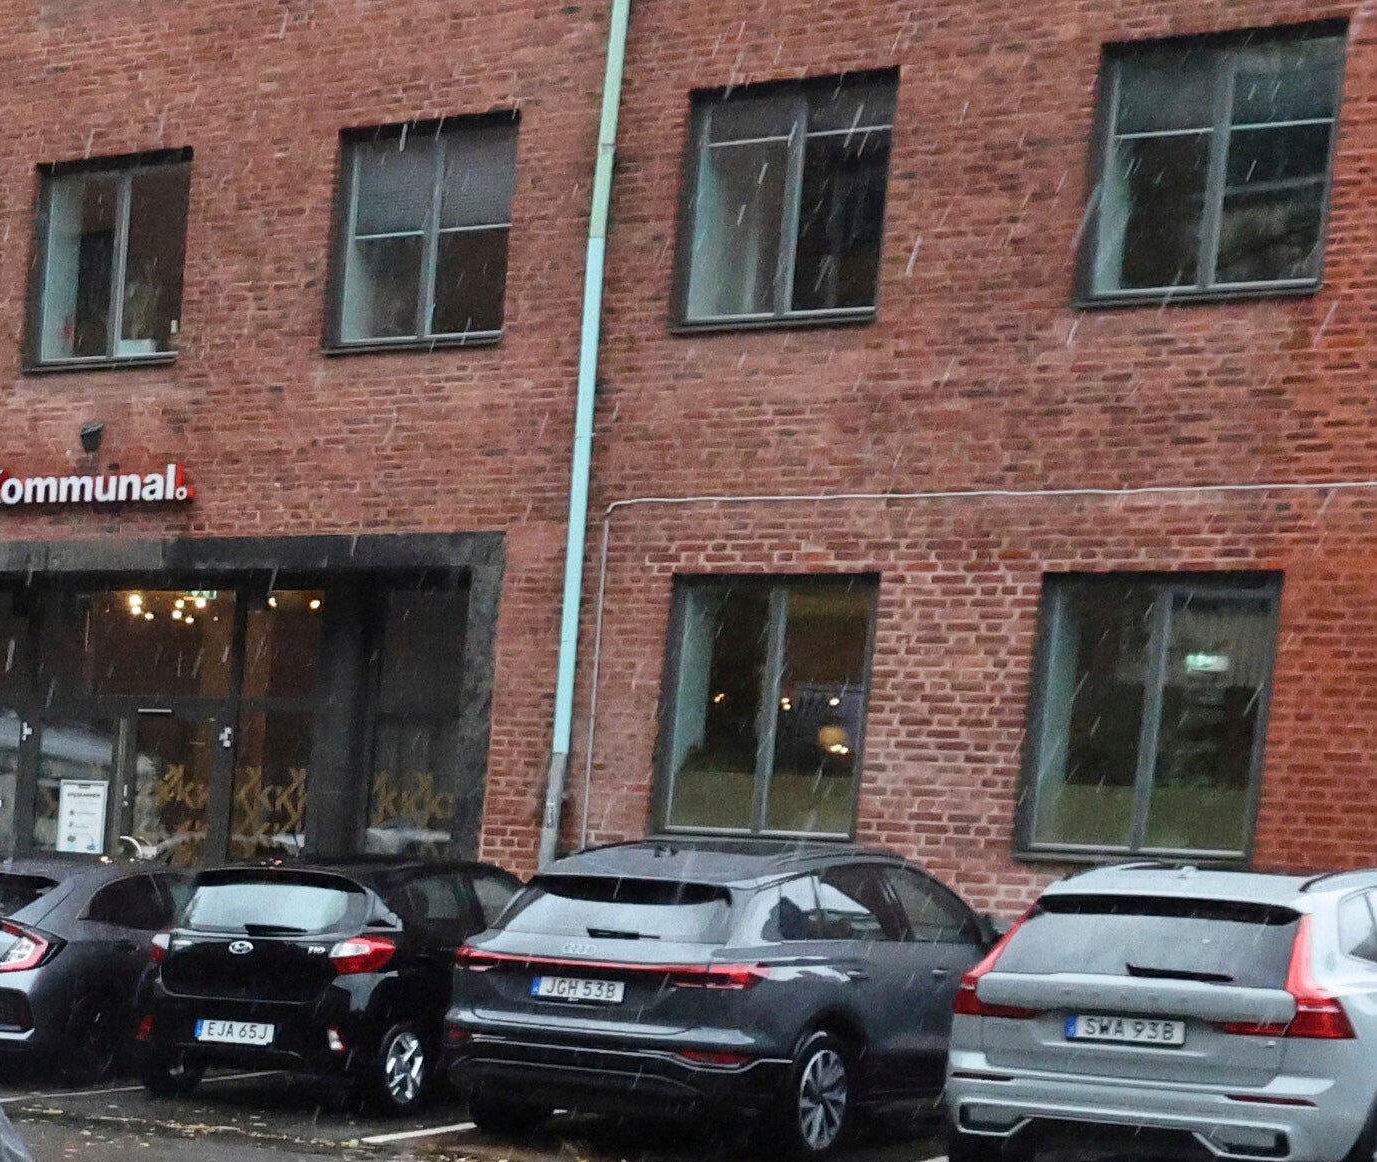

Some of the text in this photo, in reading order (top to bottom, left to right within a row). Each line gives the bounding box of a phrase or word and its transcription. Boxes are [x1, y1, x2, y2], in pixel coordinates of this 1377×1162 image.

[546, 978, 579, 995] JGH
[207, 1022, 268, 1040] EJA 65J
[1085, 1017, 1125, 1037] SWA
